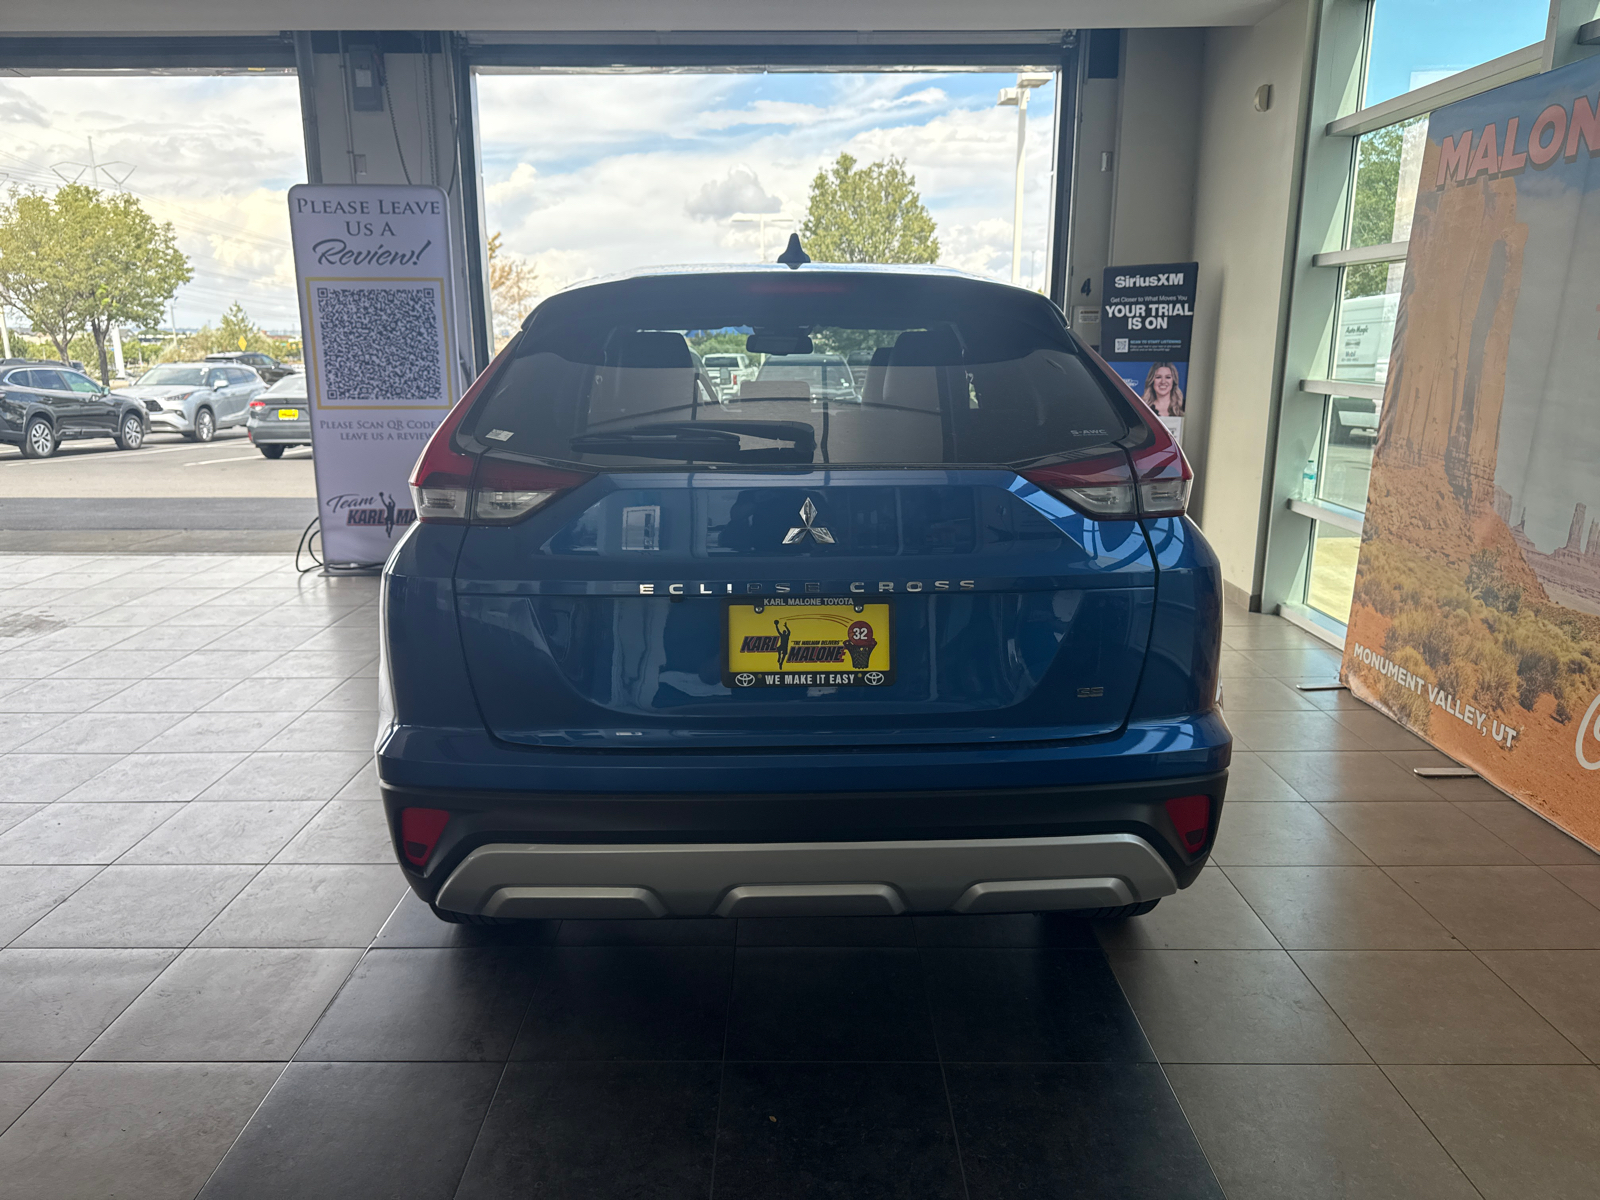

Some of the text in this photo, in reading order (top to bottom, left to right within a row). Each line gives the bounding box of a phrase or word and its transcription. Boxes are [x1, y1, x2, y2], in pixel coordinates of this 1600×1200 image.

[381, 221, 397, 236] A
[312, 238, 432, 266] Review!
[1080, 277, 1092, 297] 4
[1114, 273, 1184, 288] SiriusXM
[1105, 303, 1193, 317] YOUR TRIAL
[1127, 317, 1168, 330] IS ON
[387, 420, 405, 431] QR
[387, 433, 394, 441] A
[326, 494, 379, 513] Team
[346, 508, 385, 526] KARL
[639, 580, 975, 595] ECLIPSE CROSS
[764, 597, 854, 606] KARL MALONE TOYOTA
[853, 627, 868, 640] 32
[740, 636, 781, 653] KARL
[786, 645, 845, 663] MALONE
[765, 674, 855, 685] WE MAKE IT EASY
[1353, 642, 1424, 695] MONUMENT
[1428, 684, 1487, 737] VALLEY,
[1491, 719, 1517, 748] UT
